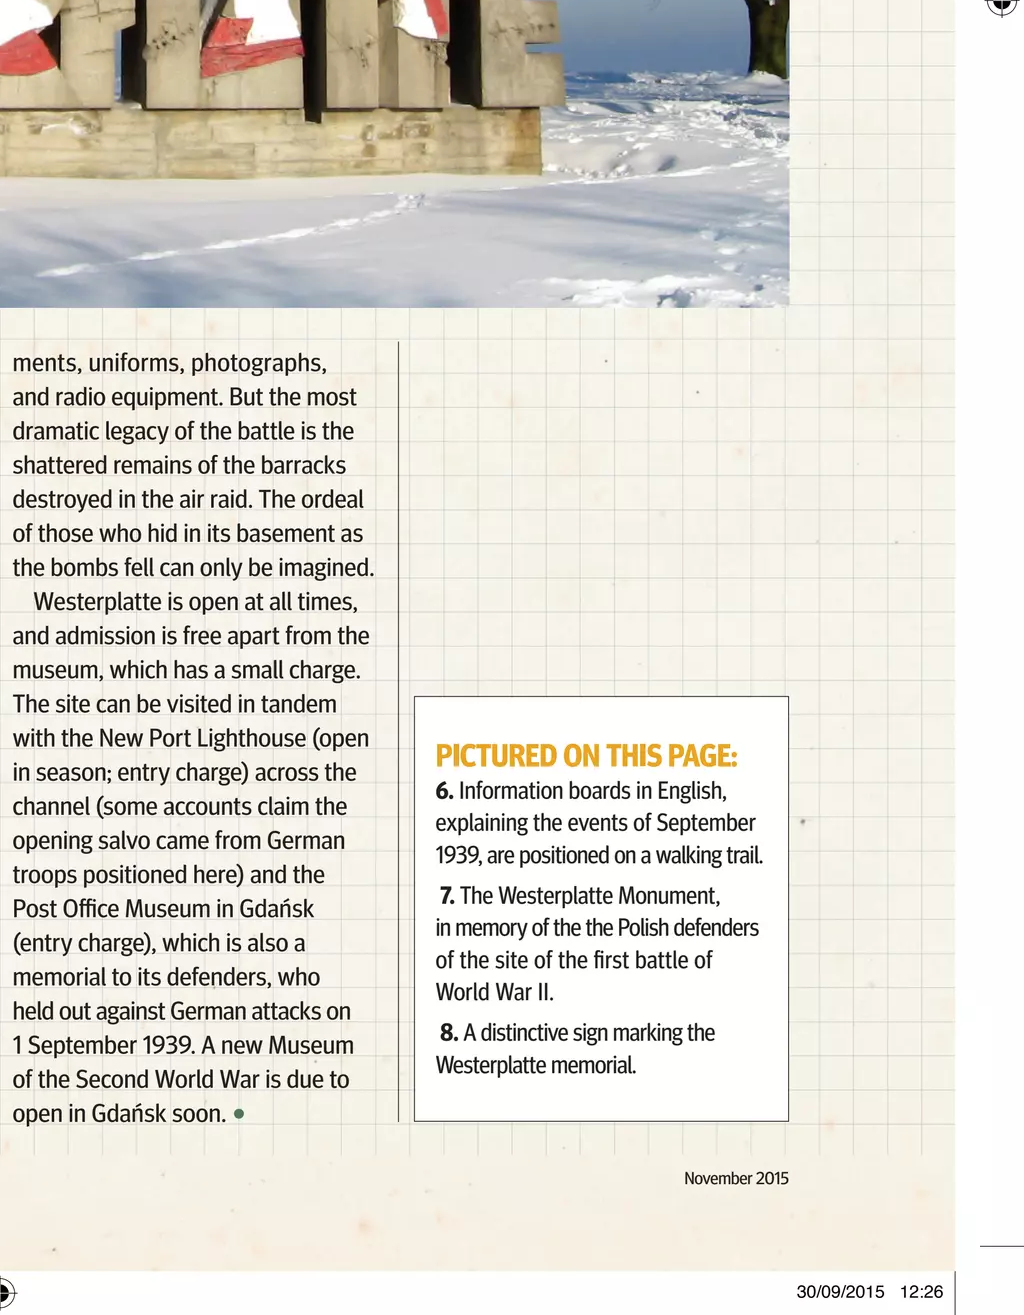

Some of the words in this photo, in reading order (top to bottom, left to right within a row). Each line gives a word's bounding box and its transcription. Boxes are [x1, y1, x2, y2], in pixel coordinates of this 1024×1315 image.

[14, 354, 81, 374] ments,
[90, 352, 184, 374] uniforms,
[192, 353, 326, 376] photographs,
[13, 387, 48, 406] and
[56, 387, 105, 406] radio
[112, 387, 223, 410] equipment.
[231, 387, 263, 406] But
[269, 387, 301, 406] the
[308, 388, 357, 406] most
[437, 744, 557, 767] PICTURED
[564, 744, 599, 767] ON
[606, 744, 662, 767] THIS
[669, 744, 737, 767] PAGE:
[436, 781, 453, 799] 6.
[461, 780, 562, 799] Information
[570, 781, 630, 799] boards
[637, 781, 651, 799] in
[659, 781, 726, 804] English,
[13, 796, 90, 815] channel
[97, 795, 157, 819] (some
[164, 798, 251, 815] accounts
[258, 796, 309, 815] claim
[315, 796, 347, 815] the
[436, 813, 528, 836] explaining
[533, 813, 562, 831] the
[568, 814, 627, 831] events
[634, 813, 652, 831] of
[657, 813, 756, 835] September
[436, 846, 482, 866] 1939,
[488, 850, 514, 864] are
[520, 845, 609, 868] positioned
[615, 850, 635, 864] on
[641, 850, 651, 864] a
[656, 845, 722, 868] walking
[727, 845, 763, 864] trail.
[14, 899, 57, 918] Post
[63, 898, 119, 918] Office
[126, 899, 210, 918] Museum
[217, 899, 233, 917] in
[240, 898, 314, 918] Gdańsk
[441, 886, 454, 904] 7.
[460, 886, 493, 904] The
[499, 886, 613, 908] Westerplatte
[619, 886, 720, 907] Monument,
[437, 918, 450, 936] in
[456, 923, 528, 940] memory
[532, 917, 550, 936] of
[553, 918, 581, 936] the
[586, 918, 613, 936] the
[619, 918, 668, 936] Polish
[674, 918, 759, 936] defenders
[436, 950, 454, 969] of
[460, 950, 489, 969] the
[496, 951, 528, 969] site
[535, 950, 553, 969] of
[558, 950, 587, 969] the
[594, 950, 629, 969] first
[636, 950, 688, 969] battle
[695, 950, 713, 969] of
[436, 982, 489, 1001] World
[496, 983, 532, 1001] War
[539, 983, 553, 1001] II.
[441, 1023, 458, 1041] 8.
[464, 1023, 476, 1041] A
[481, 1023, 568, 1041] distinctive
[573, 1023, 607, 1046] sign
[614, 1023, 683, 1046] marking
[687, 1023, 715, 1041] the
[13, 1036, 20, 1054] 1
[29, 1035, 137, 1058] September
[143, 1035, 195, 1054] 1939.
[202, 1036, 215, 1054] A
[222, 1040, 262, 1054] new
[269, 1036, 353, 1054] Museum
[436, 1055, 546, 1078] Westerplatte
[552, 1055, 636, 1074] memorial.
[13, 1108, 62, 1127] open
[70, 1104, 85, 1122] in
[92, 1103, 166, 1122] Gdańsk
[173, 1108, 226, 1122] soon.
[685, 1172, 753, 1185] November
[756, 1172, 788, 1185] 2015
[797, 1285, 884, 1298] 30/09/2015
[901, 1285, 943, 1298] 12:26
